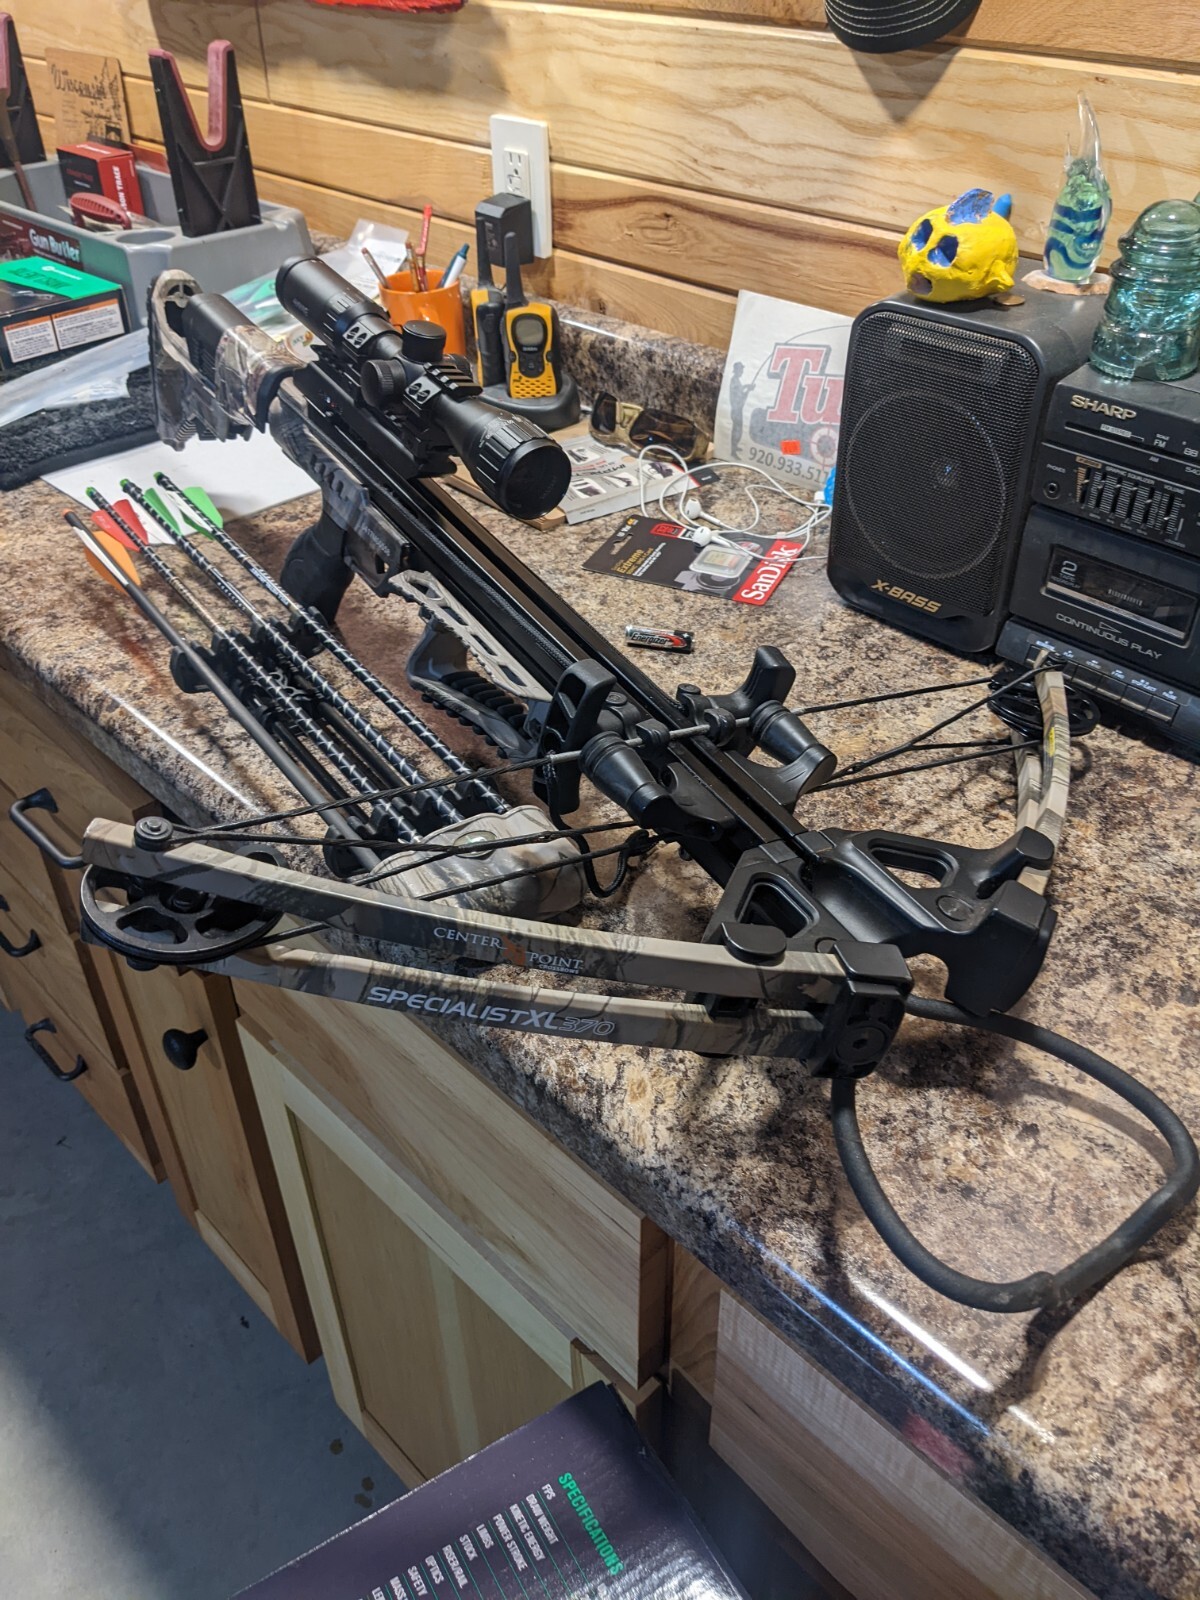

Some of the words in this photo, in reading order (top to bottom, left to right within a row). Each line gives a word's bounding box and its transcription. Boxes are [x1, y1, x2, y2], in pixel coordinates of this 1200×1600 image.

[29, 228, 49, 249] Gun
[48, 235, 80, 262] Butler
[1070, 394, 1137, 420] SHARP
[1154, 439, 1166, 448] FM
[749, 447, 829, 484] 920.933.511
[616, 549, 644, 574] Extreme
[1061, 560, 1077, 577] 2
[871, 579, 942, 613] X-BASS
[631, 631, 669, 645] Energizer
[1056, 612, 1130, 648] CONTINUOUS
[1130, 642, 1162, 660] PLAY
[433, 926, 502, 949] CENTER
[529, 952, 584, 969] POINT
[558, 1016, 616, 1036] 370
[541, 1483, 556, 1501] FPS
[509, 1503, 531, 1534] KINETIC
[524, 1530, 546, 1561] ENERGY
[525, 1493, 543, 1517] DRAW
[537, 1513, 559, 1545] WEIGHT
[558, 1472, 624, 1576] SPECIFICATIONS
[459, 1534, 478, 1561] STOCK
[476, 1523, 494, 1549] LIMBS
[492, 1513, 513, 1543] POWER
[506, 1539, 528, 1571] STROKE
[407, 1565, 428, 1596] SAFETY
[425, 1554, 444, 1584] OPTICS
[442, 1544, 469, 1589] RISER/RAIL
